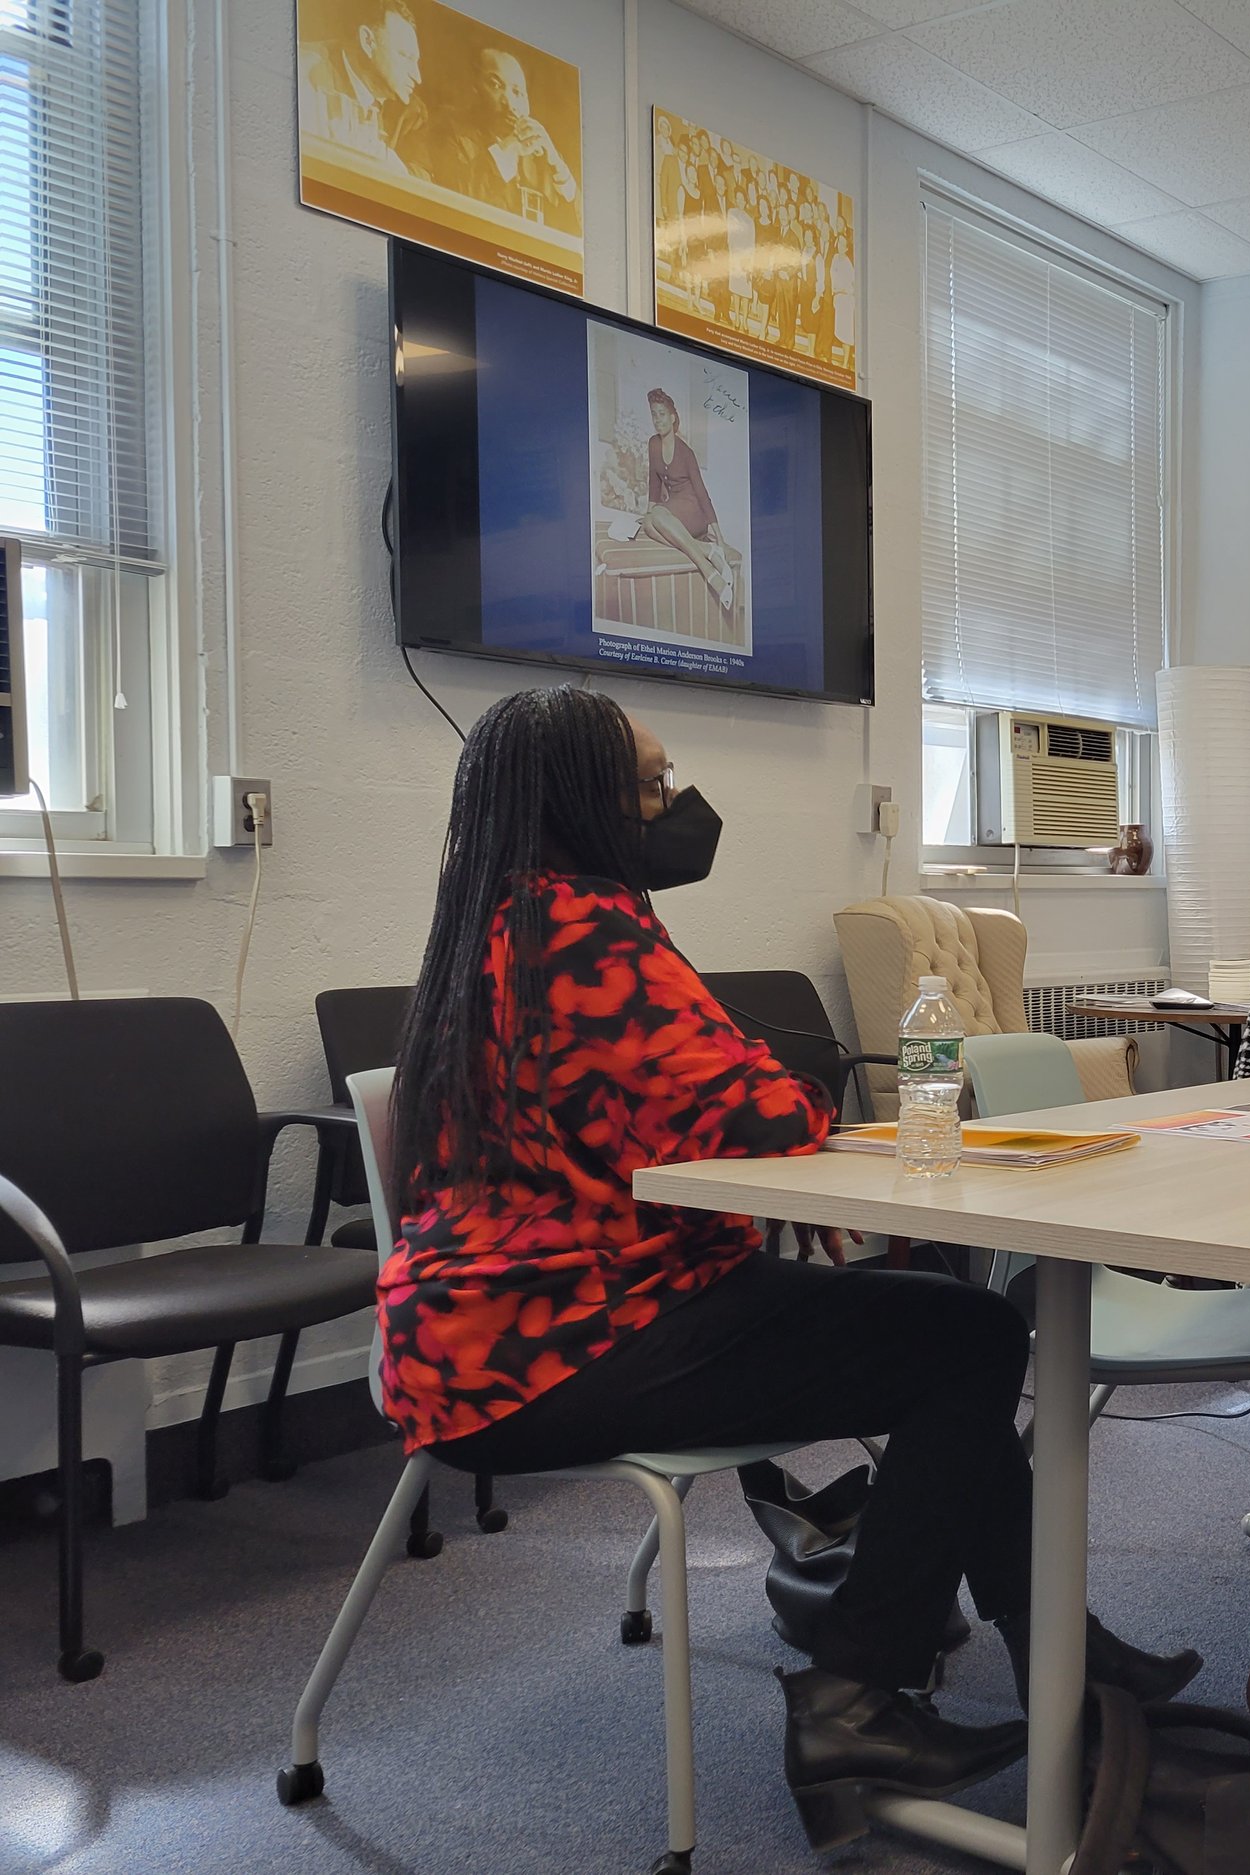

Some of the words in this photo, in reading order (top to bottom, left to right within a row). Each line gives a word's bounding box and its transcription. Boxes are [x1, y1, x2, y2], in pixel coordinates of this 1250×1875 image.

[599, 638, 632, 651] Photograph
[902, 1042, 931, 1056] Poland
[903, 1053, 933, 1067] Spring
